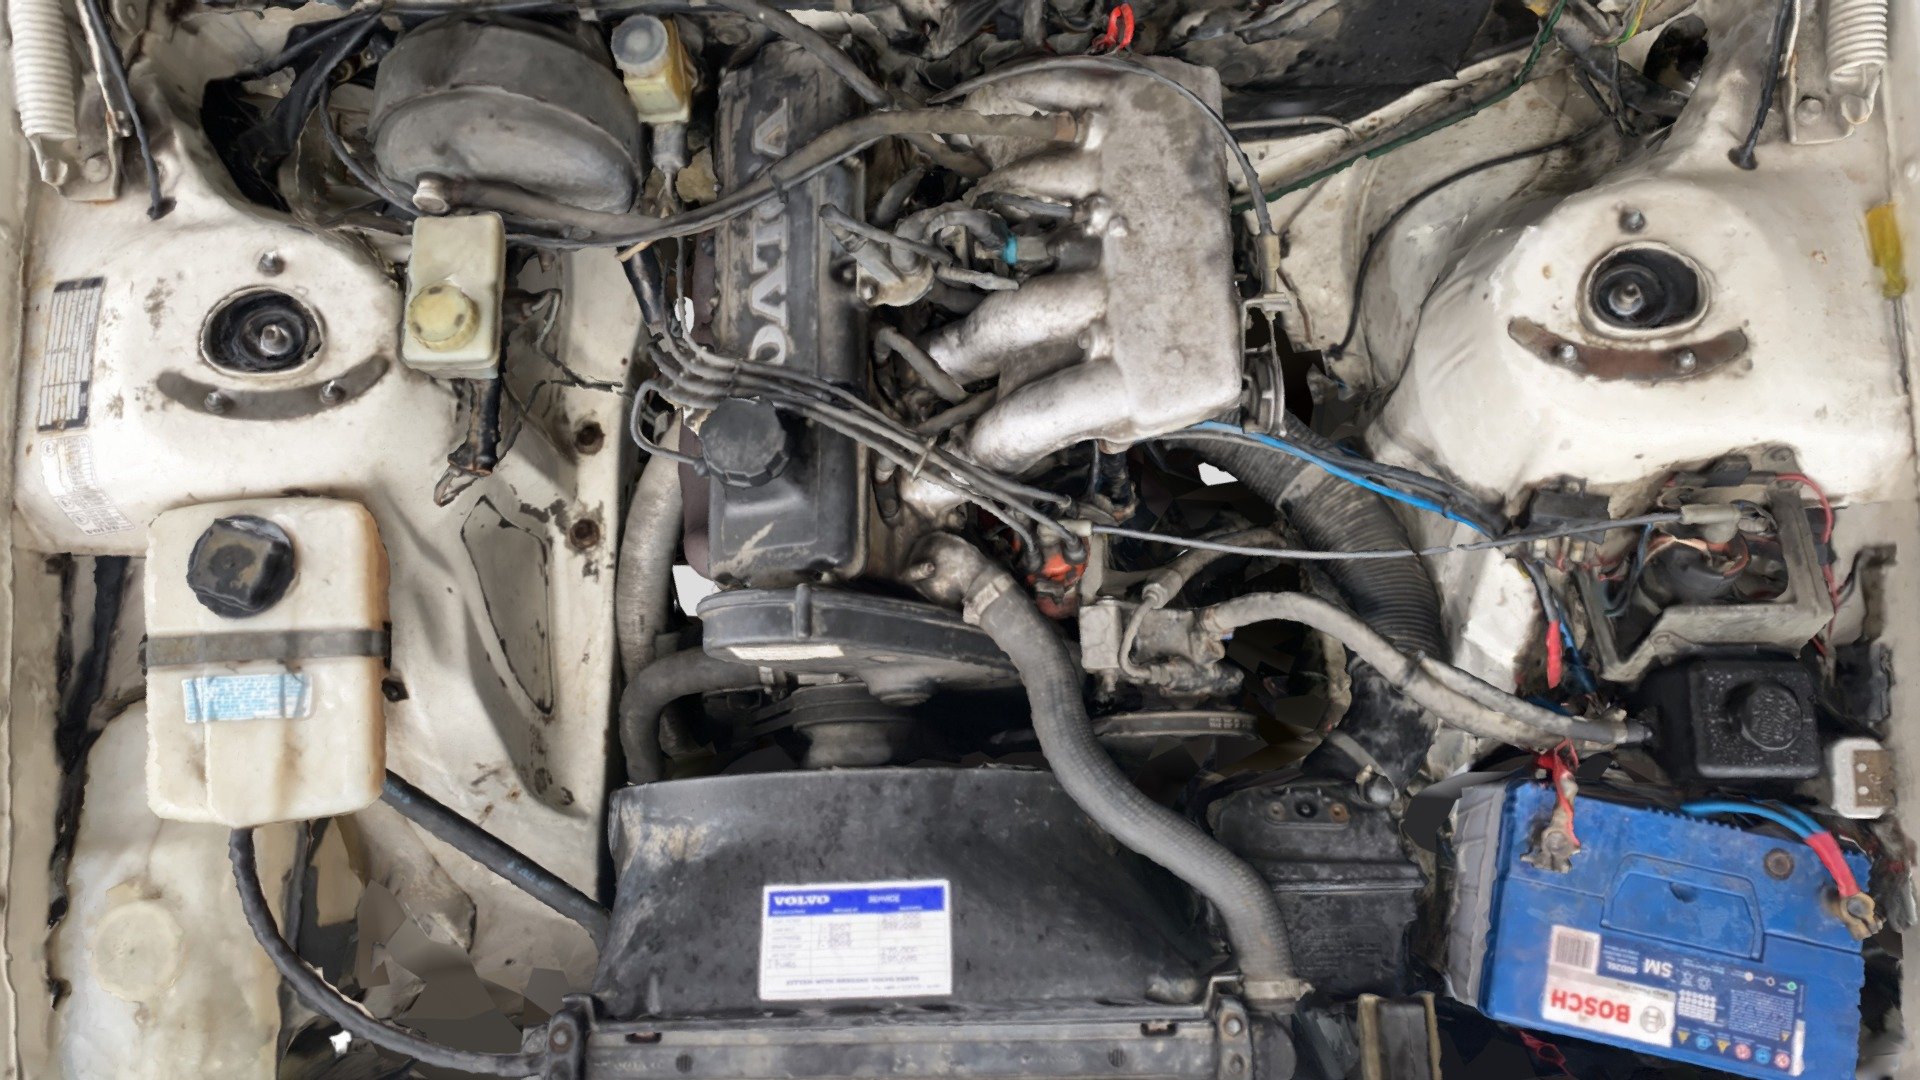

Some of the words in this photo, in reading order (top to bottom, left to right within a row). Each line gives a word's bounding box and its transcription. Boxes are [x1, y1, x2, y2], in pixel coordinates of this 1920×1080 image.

[774, 894, 831, 906] VOLVO
[868, 893, 900, 904] SERVICE
[1643, 957, 1674, 978] SM
[1550, 988, 1631, 1024] BOSCH
